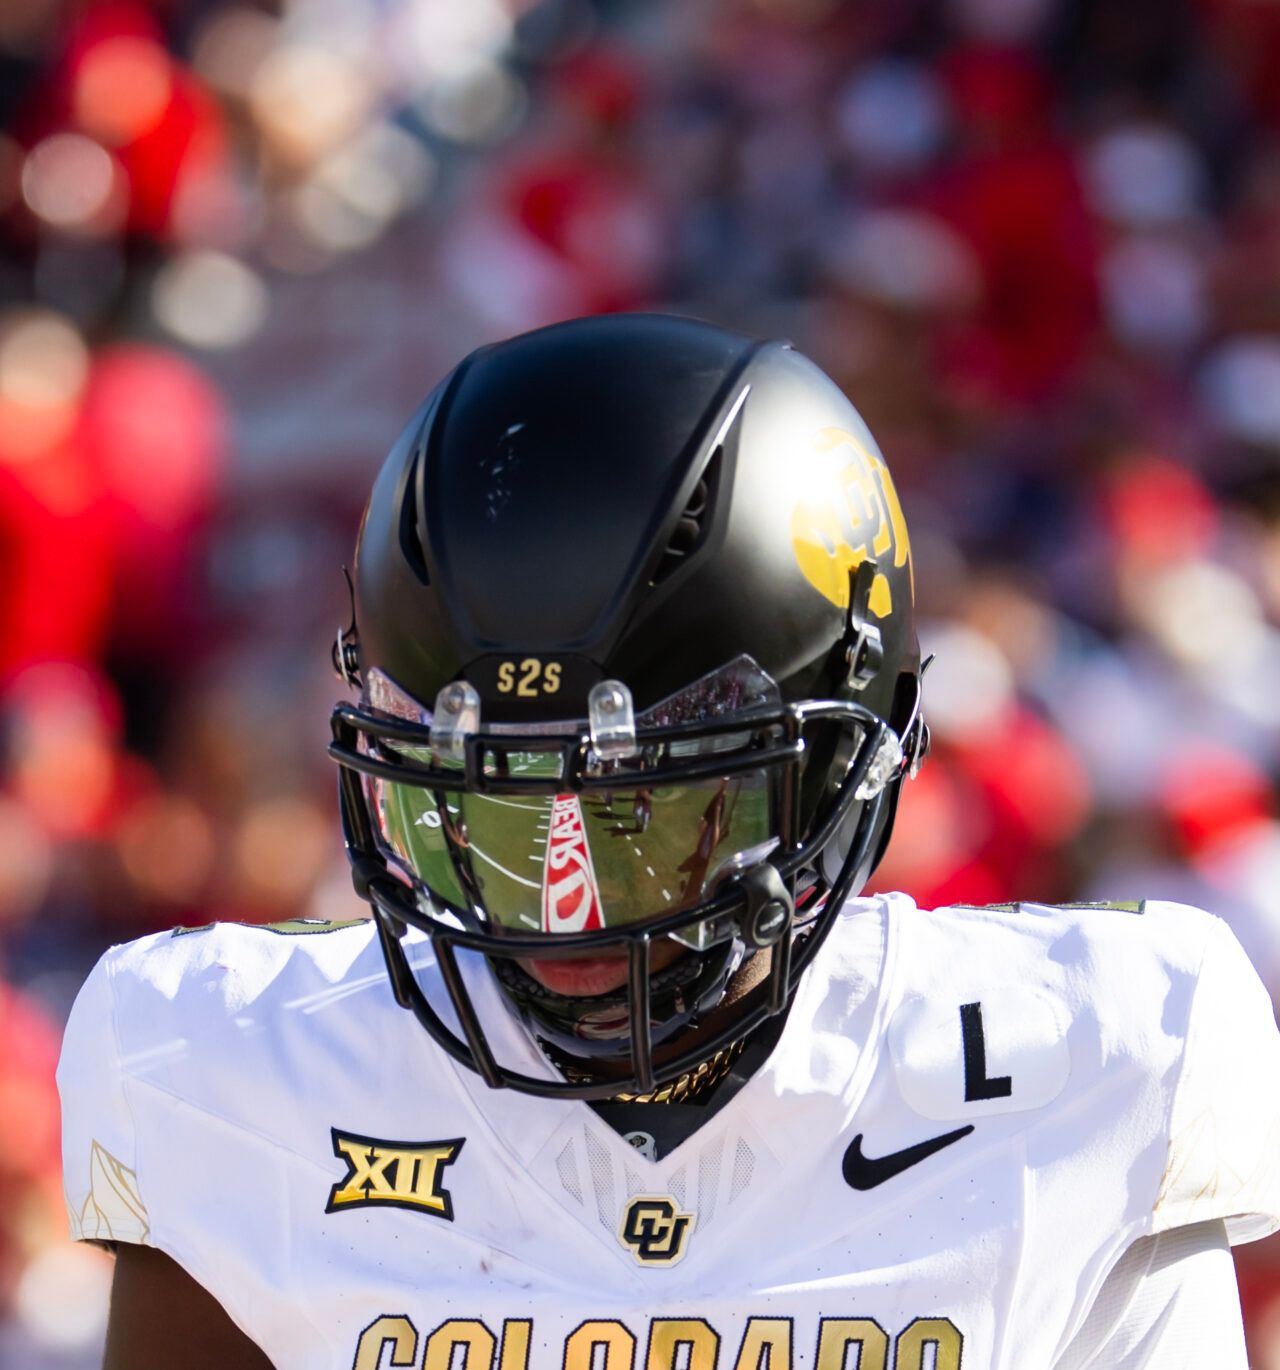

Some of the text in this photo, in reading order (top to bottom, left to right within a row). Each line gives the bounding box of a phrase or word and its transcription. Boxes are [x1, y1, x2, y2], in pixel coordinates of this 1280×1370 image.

[959, 1001, 1012, 1102] L
[329, 1131, 461, 1217] XII
[621, 1197, 692, 1264] CU
